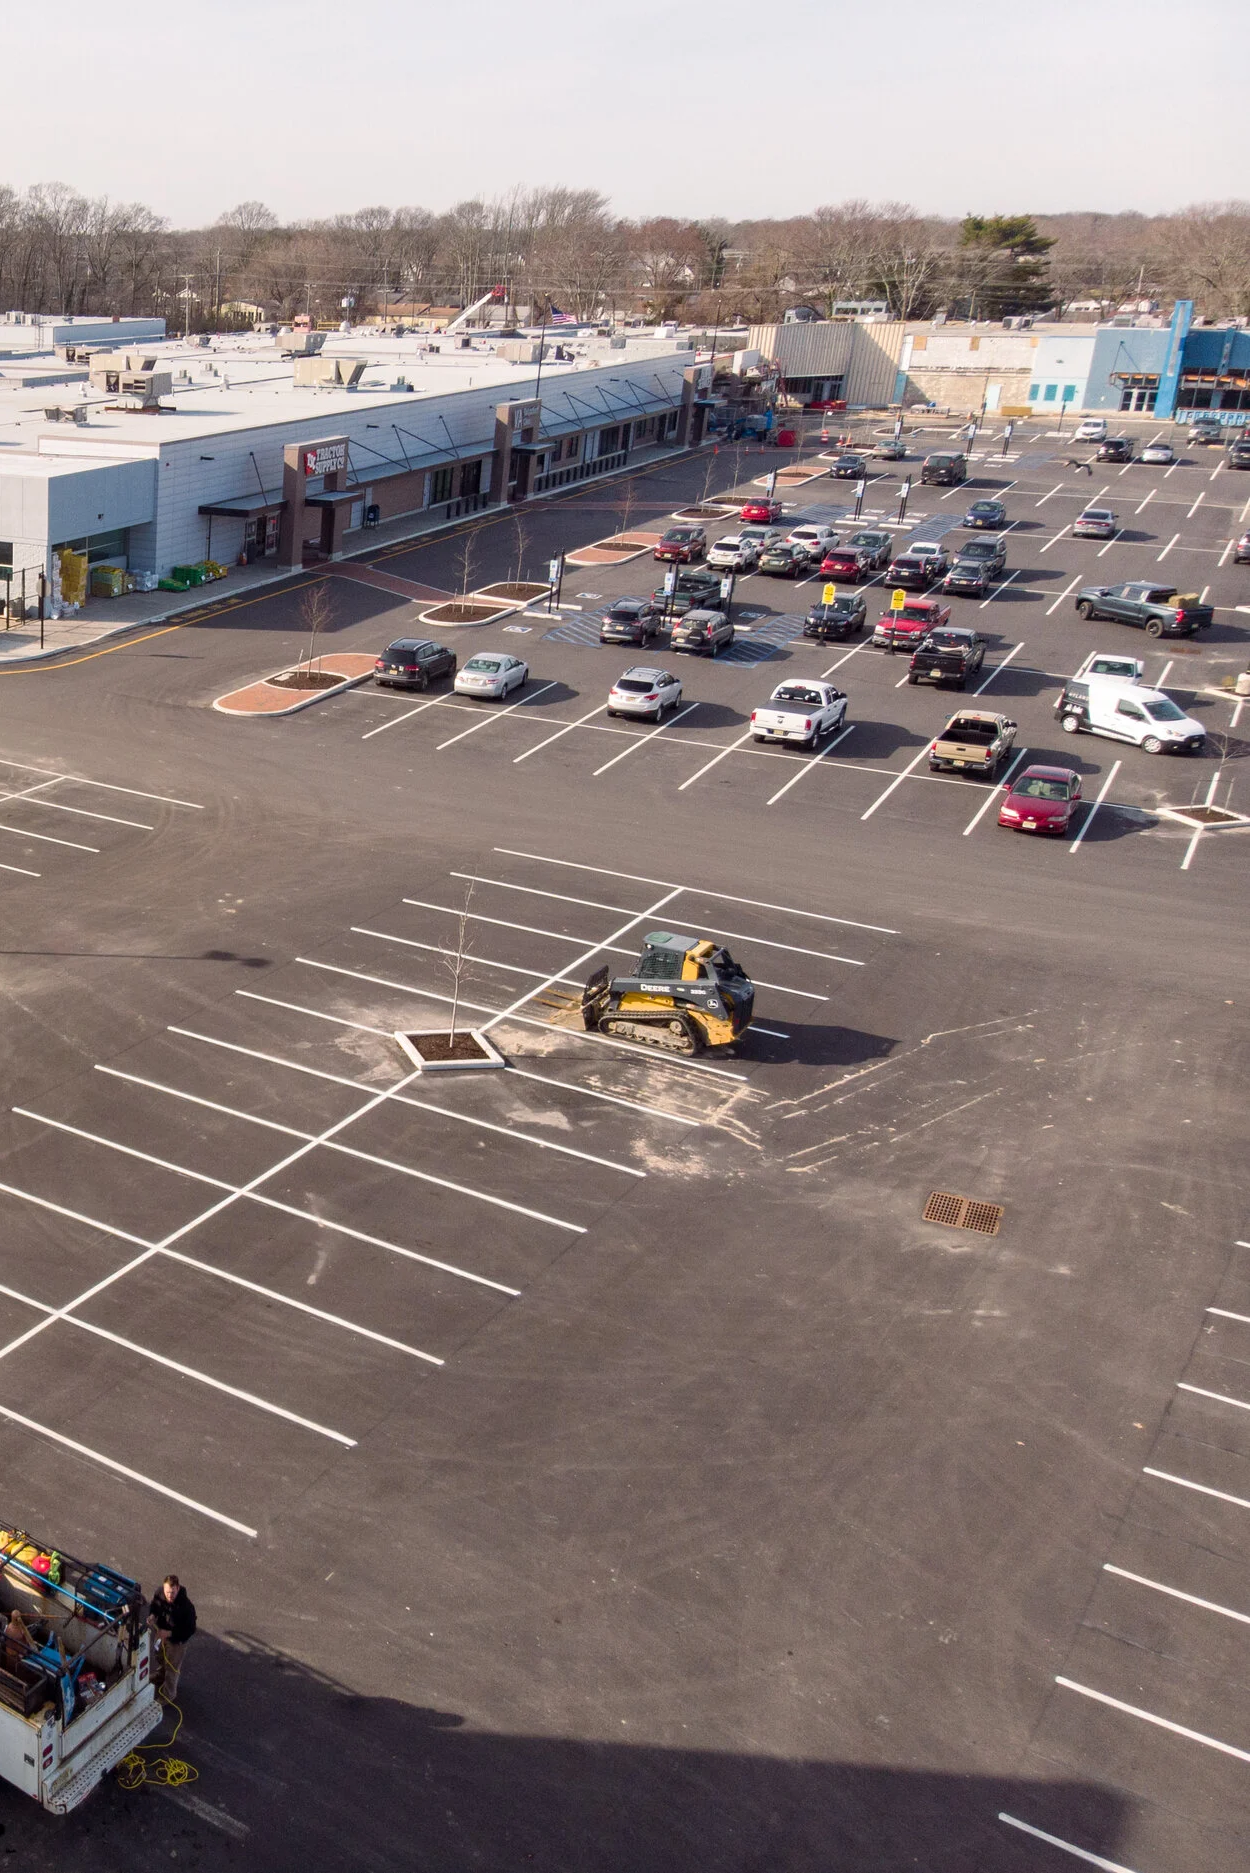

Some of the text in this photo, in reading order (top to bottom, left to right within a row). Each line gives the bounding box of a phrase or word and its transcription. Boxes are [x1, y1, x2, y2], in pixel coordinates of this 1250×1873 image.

[316, 444, 346, 460] TRACTOR
[315, 459, 337, 474] SUPPLY
[640, 983, 671, 993] DEERE
